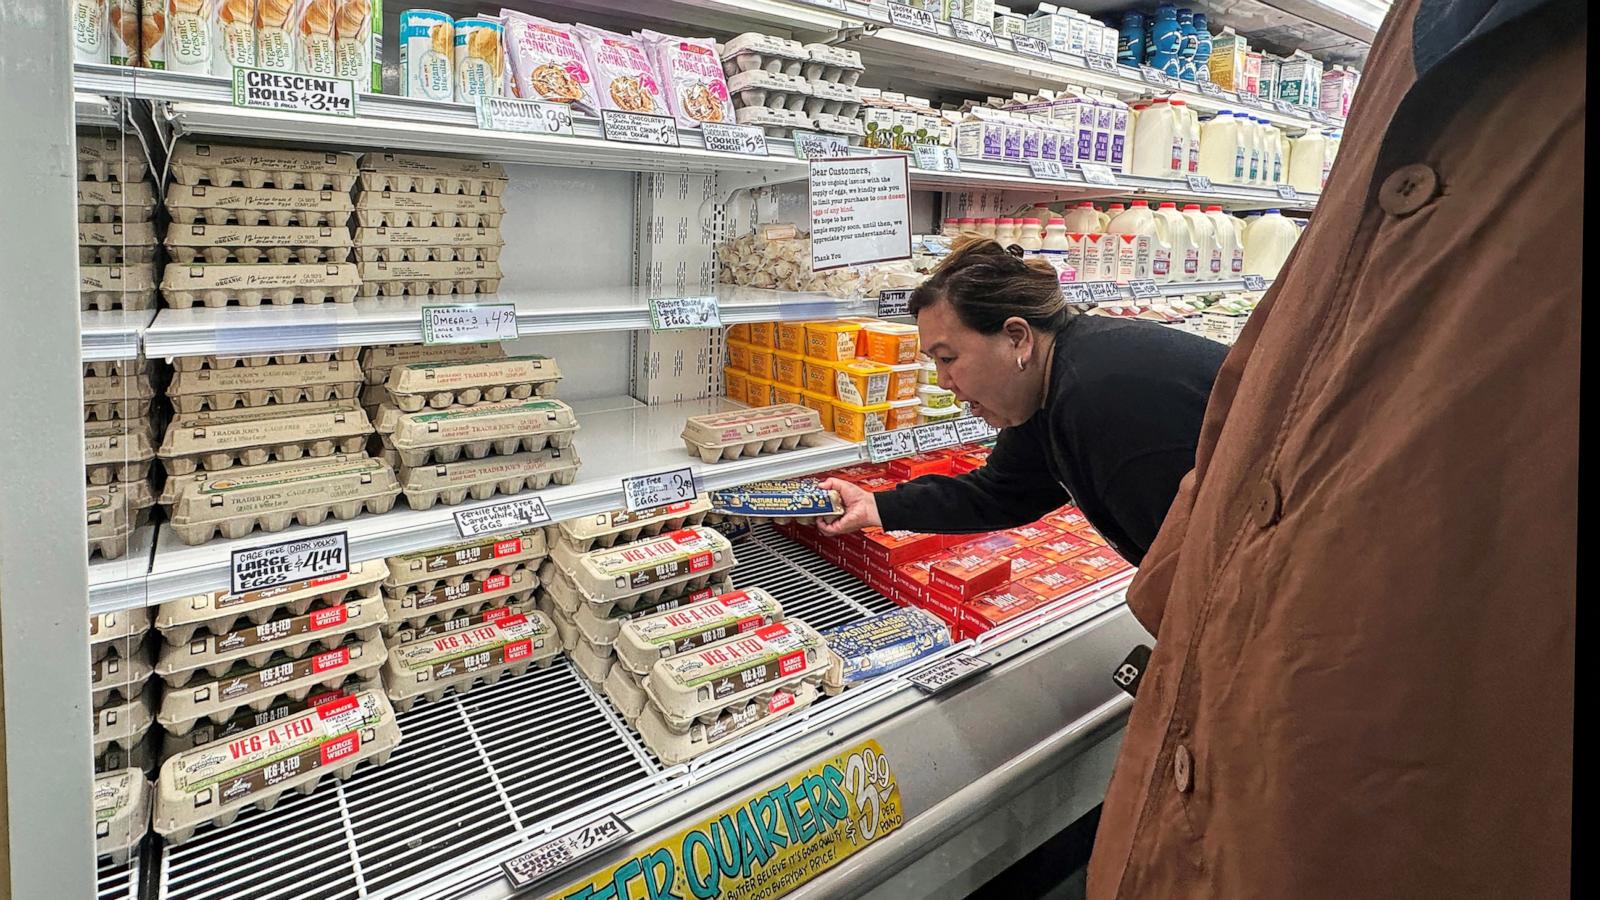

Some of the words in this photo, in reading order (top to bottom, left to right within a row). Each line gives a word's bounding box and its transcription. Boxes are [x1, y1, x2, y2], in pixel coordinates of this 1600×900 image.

[178, 20, 191, 55] Organic
[190, 19, 201, 57] Crescent
[236, 29, 244, 64] Organic
[265, 33, 275, 67] Organic
[274, 32, 285, 67] Crescent
[312, 40, 323, 73] Organic
[340, 44, 350, 76] Organic
[349, 43, 358, 77] Crescent
[247, 71, 338, 94] CRESCENT
[432, 59, 441, 91] Organic
[469, 61, 477, 95] Organic
[248, 87, 298, 102] ROLLS
[490, 100, 543, 119] BISCUITS
[706, 136, 740, 146] COOKIE
[710, 142, 741, 151] DOUGH
[812, 168, 827, 176] Dear
[828, 167, 871, 176] Customers,
[844, 196, 869, 205] purchase
[829, 225, 846, 234] supply
[877, 220, 893, 228] then,
[840, 233, 853, 242] your
[656, 300, 680, 308] Pasture
[881, 292, 906, 301] BUTTER
[658, 307, 677, 317] Large
[664, 314, 691, 327] EGGS
[627, 480, 644, 491] Cage
[646, 476, 662, 485] Free
[634, 493, 659, 507] EGGS
[460, 508, 491, 519] Fertile
[493, 504, 512, 514] Cage
[514, 499, 534, 508] Free
[462, 514, 489, 526] Large
[490, 510, 513, 521] White
[472, 520, 503, 534] EGGS
[455, 546, 481, 561] VEG-A-FED
[498, 542, 517, 550] LARGE
[498, 546, 517, 555] WHITE
[621, 540, 677, 563] VEG-A-FED
[240, 552, 263, 563] CAGE
[265, 547, 285, 557] FREE
[236, 554, 289, 574] LARGE
[238, 562, 293, 581] WHITE
[240, 573, 288, 590] EGGS
[315, 608, 342, 620] LARGE
[315, 613, 342, 625] WHITE
[665, 603, 724, 628] VEG-A-FED
[256, 617, 292, 637] VEG-A-FED
[840, 622, 878, 639] PASTURE
[879, 614, 908, 627] RAISED
[433, 626, 496, 652] VEG-A-FED
[317, 650, 344, 662] LARGE
[508, 643, 528, 654] LARGE
[508, 648, 528, 659] WHITE
[700, 638, 764, 667] VEG-A-FED
[317, 656, 344, 669] WHITE
[463, 651, 491, 668] VEG-A-FED
[782, 655, 801, 667] LARGE
[783, 661, 802, 673] WHITE
[259, 662, 294, 682] VEG-A-FED
[741, 665, 767, 684] VEG-A-FED
[313, 693, 338, 706] LARGE
[255, 705, 289, 726] VEG-A-FED
[324, 702, 354, 717] LARGE
[325, 710, 351, 723] GRADE
[228, 717, 314, 761] VEG-A-FED
[326, 738, 354, 754] LARGE
[326, 744, 354, 761] WHITE
[263, 755, 301, 781] VEG-A-FED
[881, 802, 897, 820] PER
[682, 763, 850, 900] QUARTERS
[879, 814, 903, 835] POUND
[510, 851, 538, 868] CAGE
[540, 839, 566, 853] FREE
[513, 844, 567, 873] LARGE
[726, 878, 757, 900] BUTTER
[756, 859, 787, 886] BELIEVE
[788, 852, 802, 868] IT'S
[802, 846, 819, 861] GOOD
[818, 830, 843, 852] QUALITY
[771, 864, 808, 893] EVERYDAY
[810, 846, 838, 872] PRICE!
